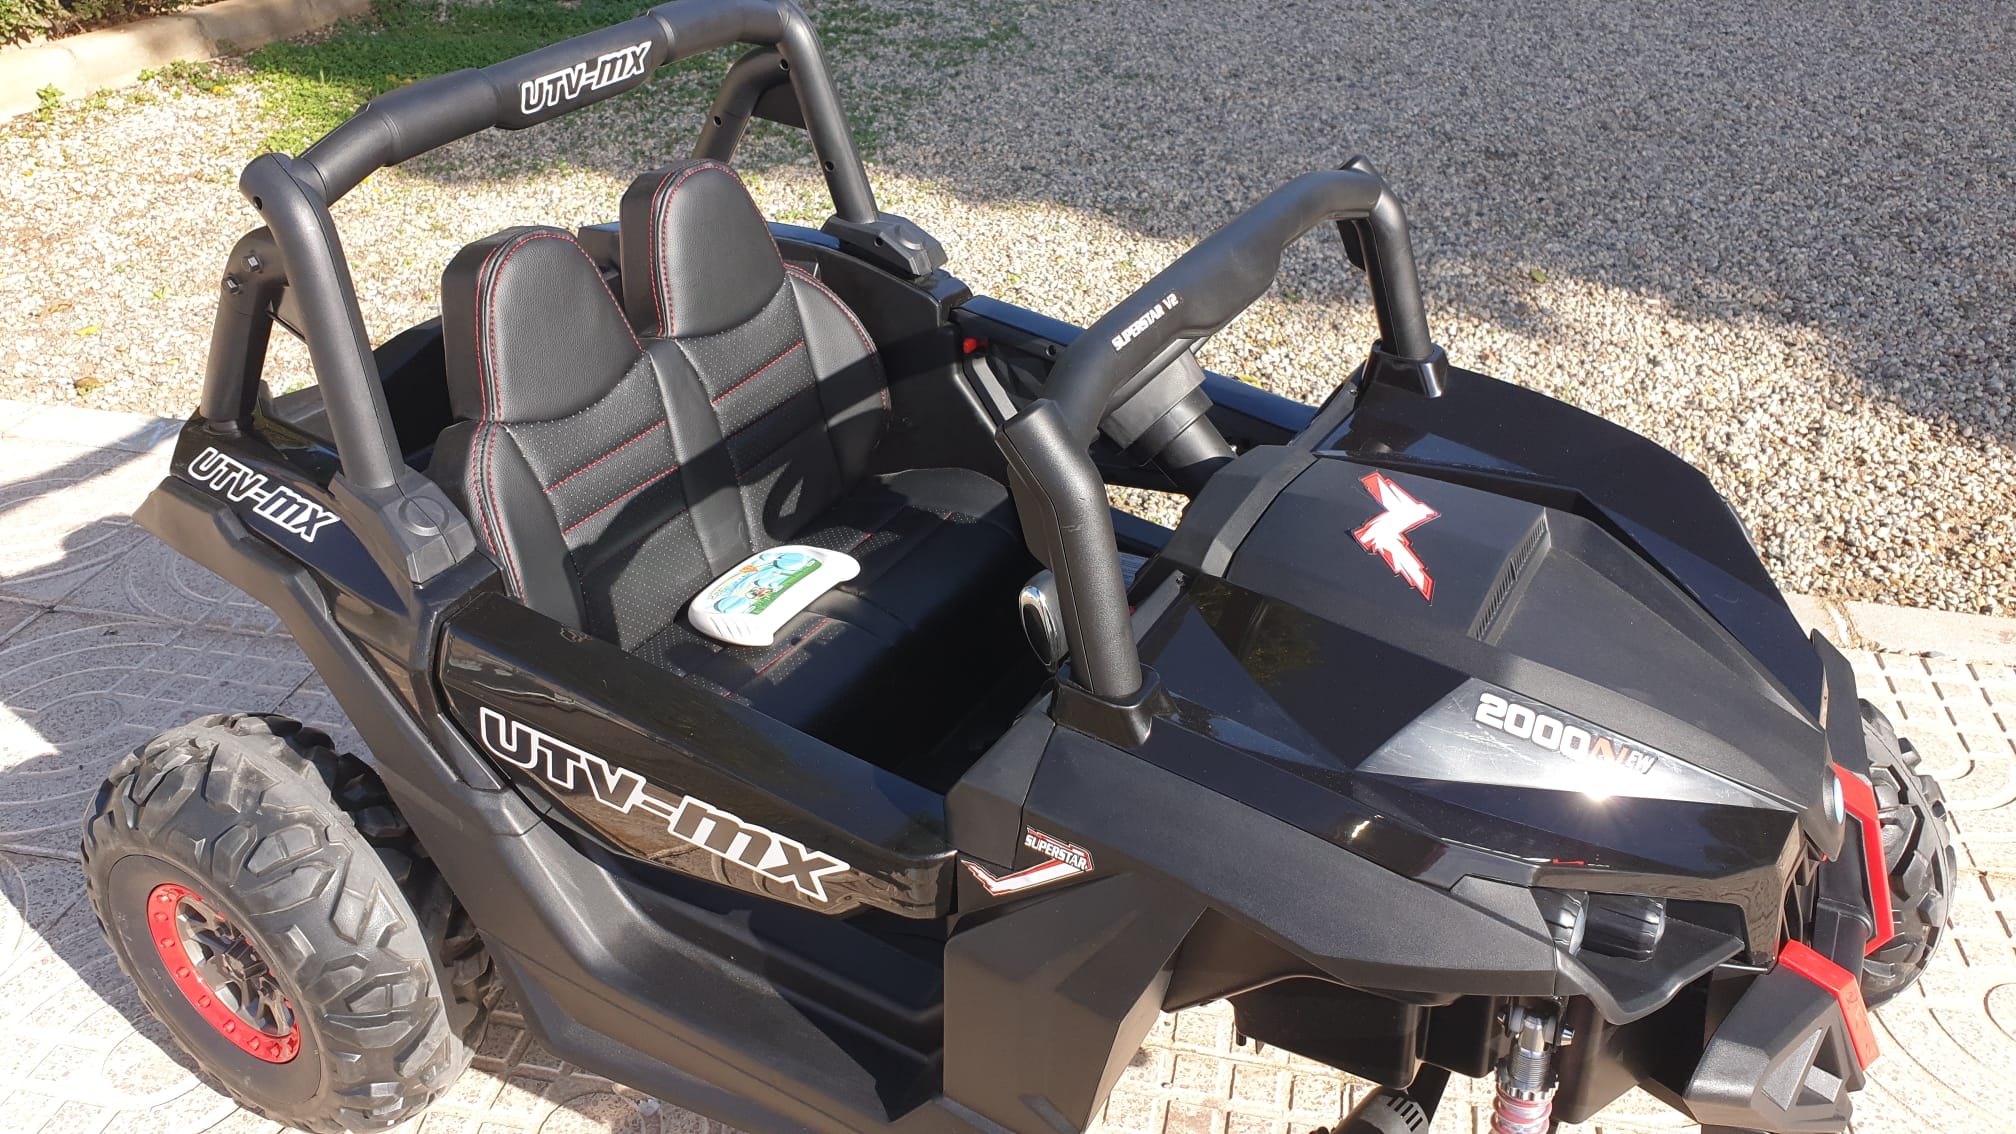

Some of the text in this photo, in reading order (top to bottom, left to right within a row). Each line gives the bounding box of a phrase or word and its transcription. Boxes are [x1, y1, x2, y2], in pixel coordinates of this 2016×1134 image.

[521, 41, 652, 114] UTV-MX
[1111, 293, 1179, 351] SUPERSTAR V2
[187, 446, 341, 543] UTV-MX
[479, 706, 850, 902] UTV-MX
[1024, 834, 1089, 871] SUPERSTAR
